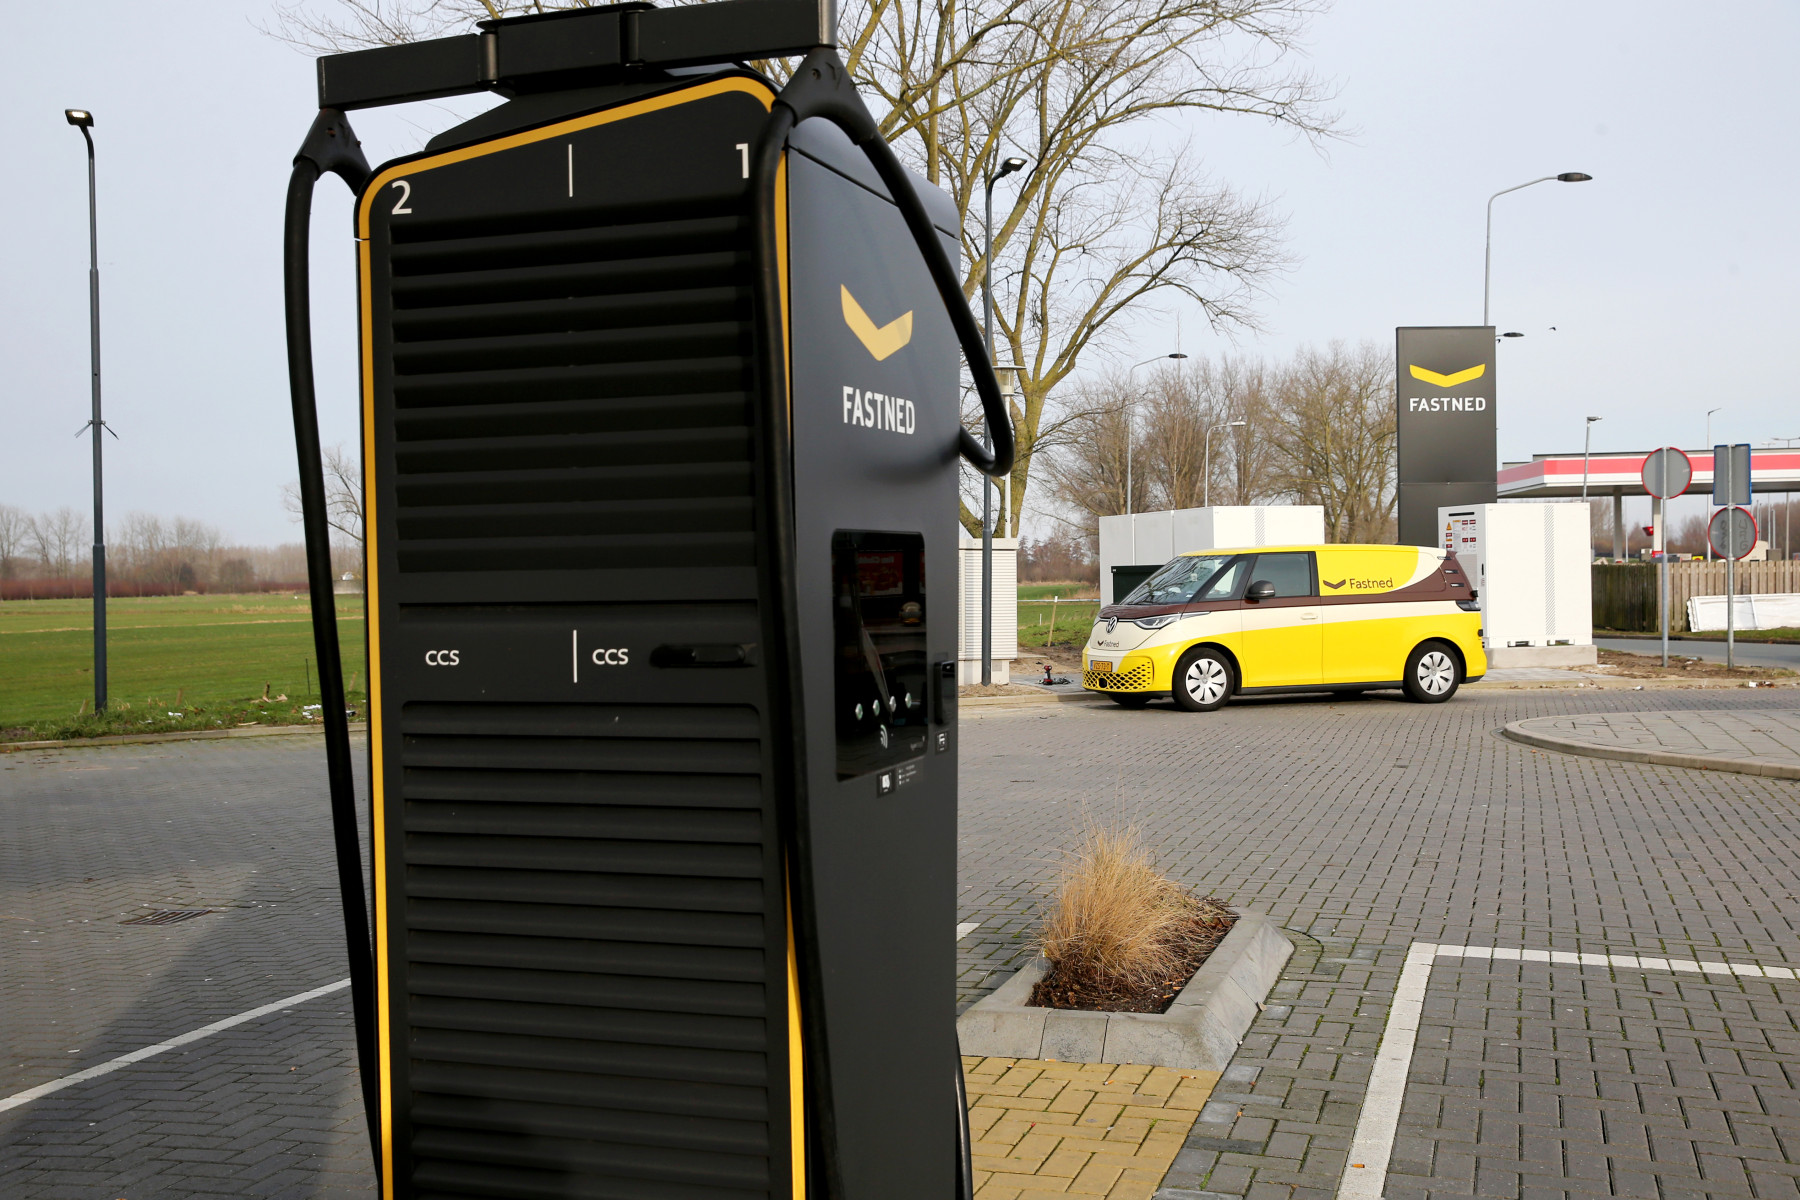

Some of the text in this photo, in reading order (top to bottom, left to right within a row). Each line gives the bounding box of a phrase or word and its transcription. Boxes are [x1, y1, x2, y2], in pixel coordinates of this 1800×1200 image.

[735, 143, 750, 179] 1
[391, 179, 413, 215] 2
[842, 385, 916, 435] FASTNED
[1409, 396, 1487, 412] FASTNED
[1349, 577, 1394, 589] Fastned
[1103, 640, 1119, 648] Fastned
[424, 649, 460, 666] CCS
[592, 648, 629, 665] CCS
